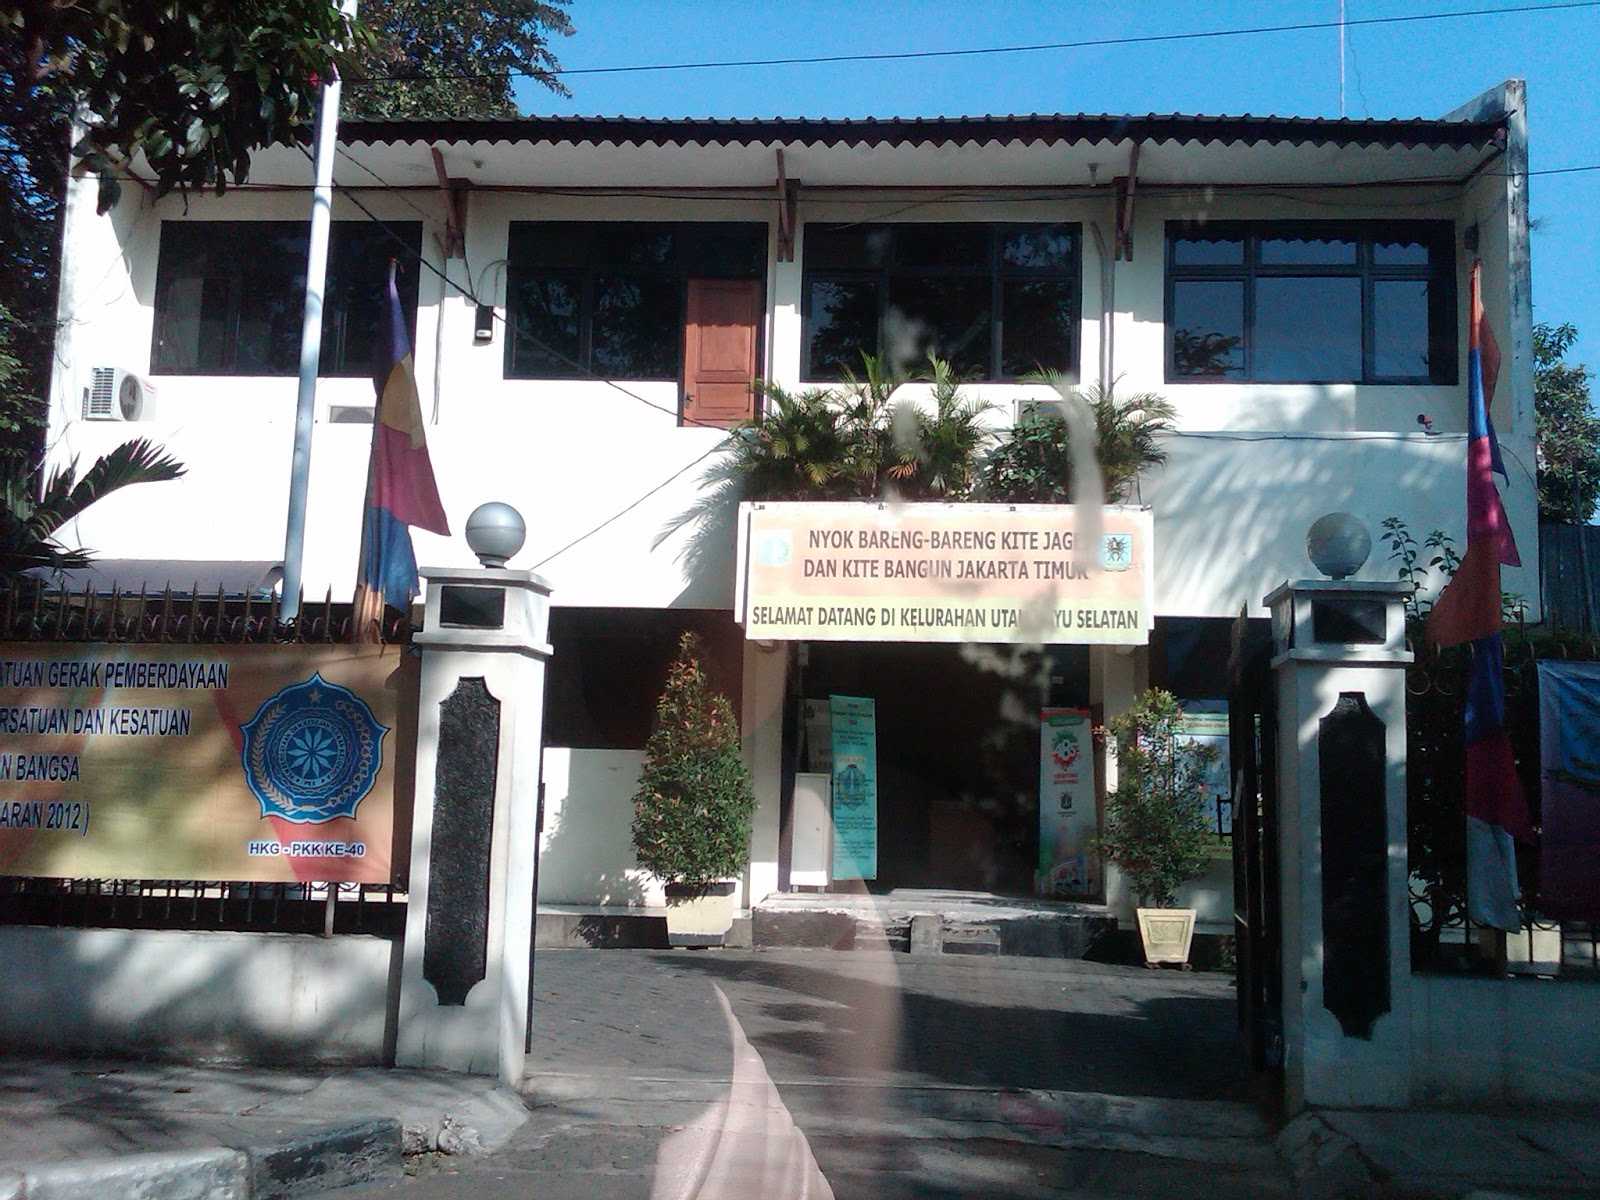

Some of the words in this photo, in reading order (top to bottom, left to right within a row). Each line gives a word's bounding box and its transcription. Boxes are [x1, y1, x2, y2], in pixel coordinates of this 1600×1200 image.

[809, 530, 854, 549] NYOK
[858, 530, 996, 550] BARENG-BARENG
[1001, 531, 1038, 550] KITE
[1043, 531, 1081, 550] JAG
[804, 559, 837, 578] DAN
[842, 559, 879, 578] KITE
[884, 560, 951, 579] BANGUN
[956, 560, 1029, 579] JAKARTA
[752, 606, 813, 625] SELAMAT
[818, 607, 876, 626] DATANG
[881, 608, 895, 626] DI
[900, 608, 986, 628] KELURAHAN
[991, 608, 1027, 628] UTA
[1077, 610, 1138, 629] SELATAN
[0, 661, 45, 687] TUAN
[48, 661, 102, 687] GERAK
[104, 662, 229, 689] PEMBERDAYAAN
[73, 708, 105, 735] DAN
[109, 709, 191, 736] KESATUAN
[16, 755, 80, 781] BANGSA
[249, 842, 280, 855] HKG
[292, 843, 322, 856] PKK
[324, 843, 365, 856] KE-40
